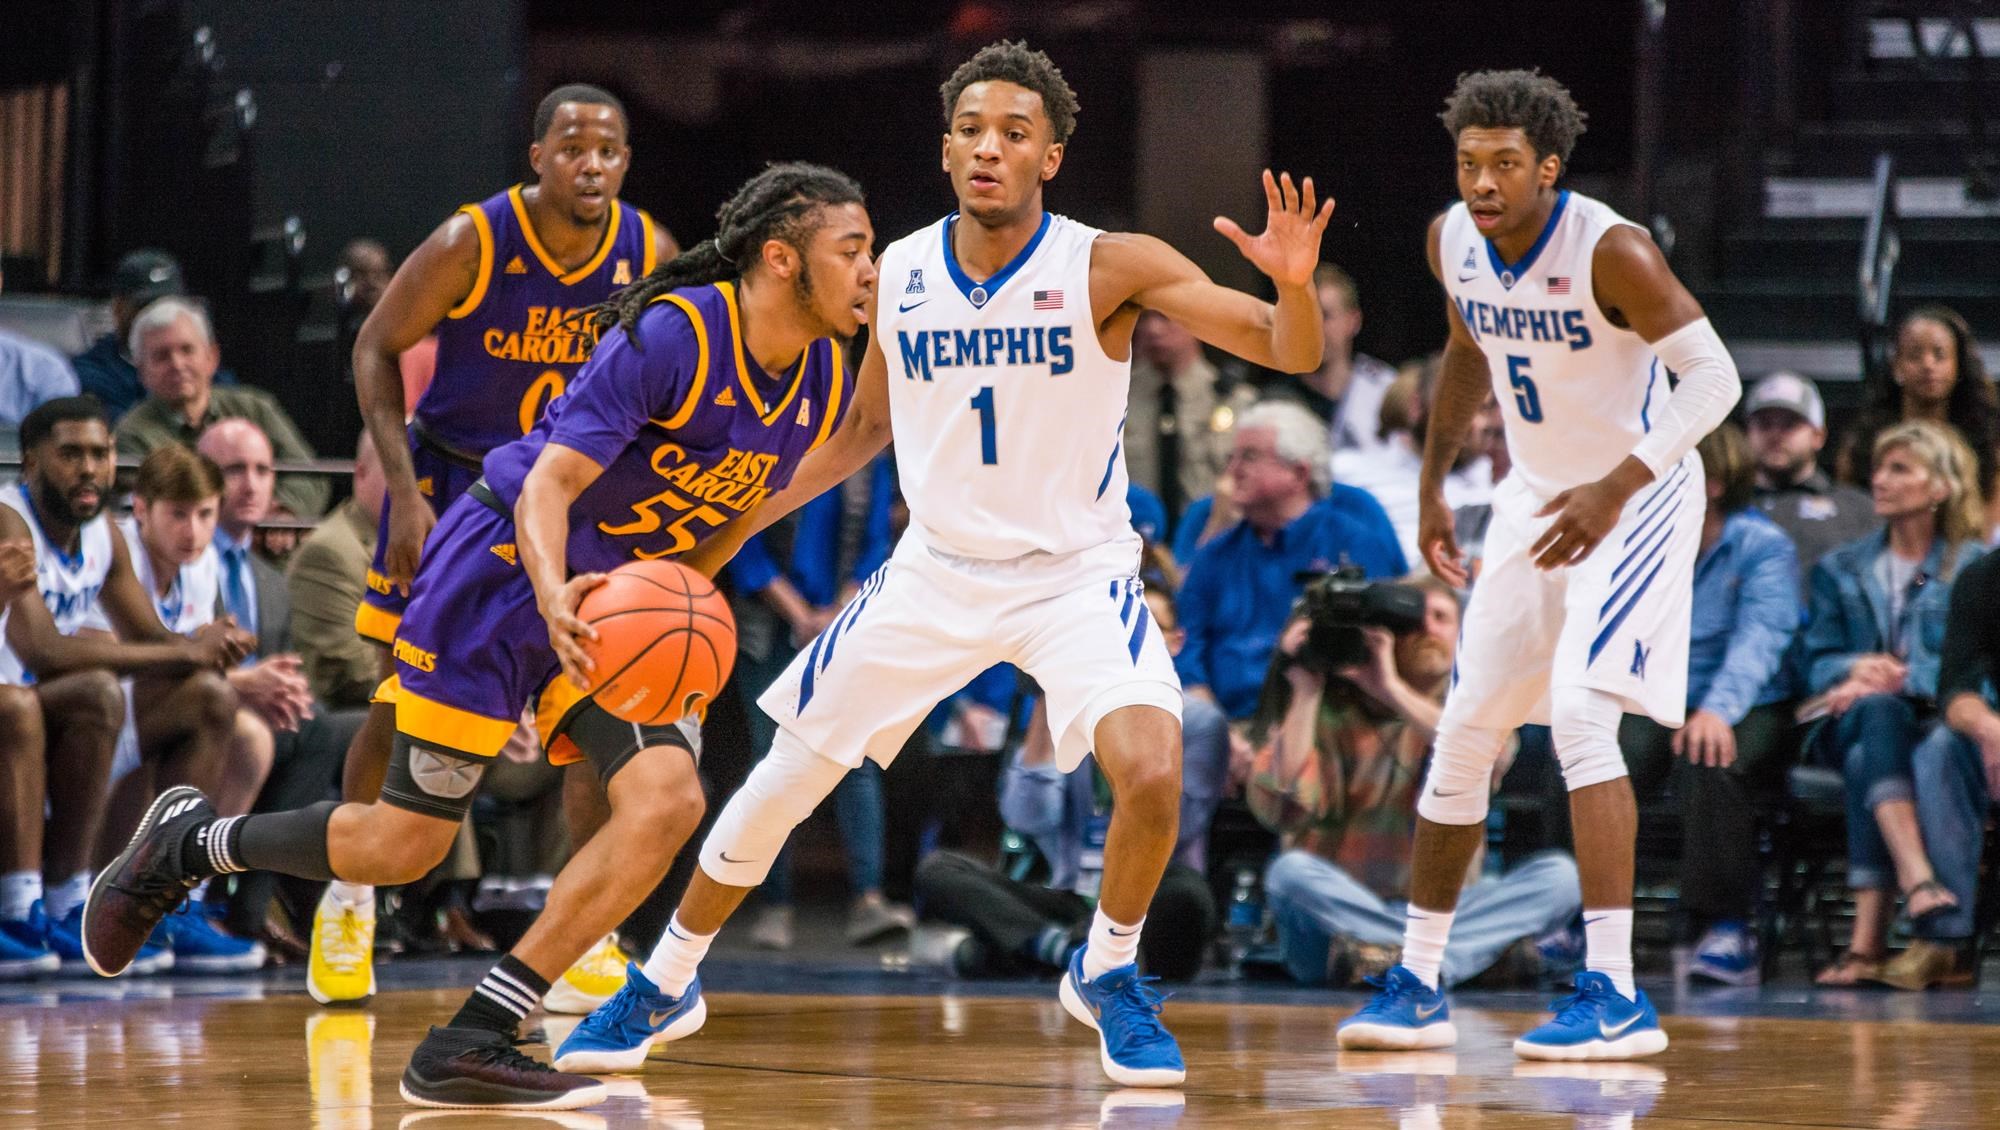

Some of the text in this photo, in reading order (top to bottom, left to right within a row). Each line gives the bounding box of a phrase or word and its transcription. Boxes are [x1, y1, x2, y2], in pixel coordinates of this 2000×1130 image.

[612, 259, 633, 285] A
[906, 269, 926, 294] A
[483, 328, 592, 364] CAROLI
[524, 306, 600, 337] EAST
[1455, 295, 1593, 352] MEMPHIS
[897, 325, 1075, 382] MEMPHIS
[519, 370, 566, 435] 0
[795, 398, 811, 427] A
[1506, 354, 1544, 424] 5
[970, 386, 998, 465] 1
[650, 443, 773, 512] CAROLIN
[707, 448, 780, 488] EAST
[598, 489, 729, 561] 55
